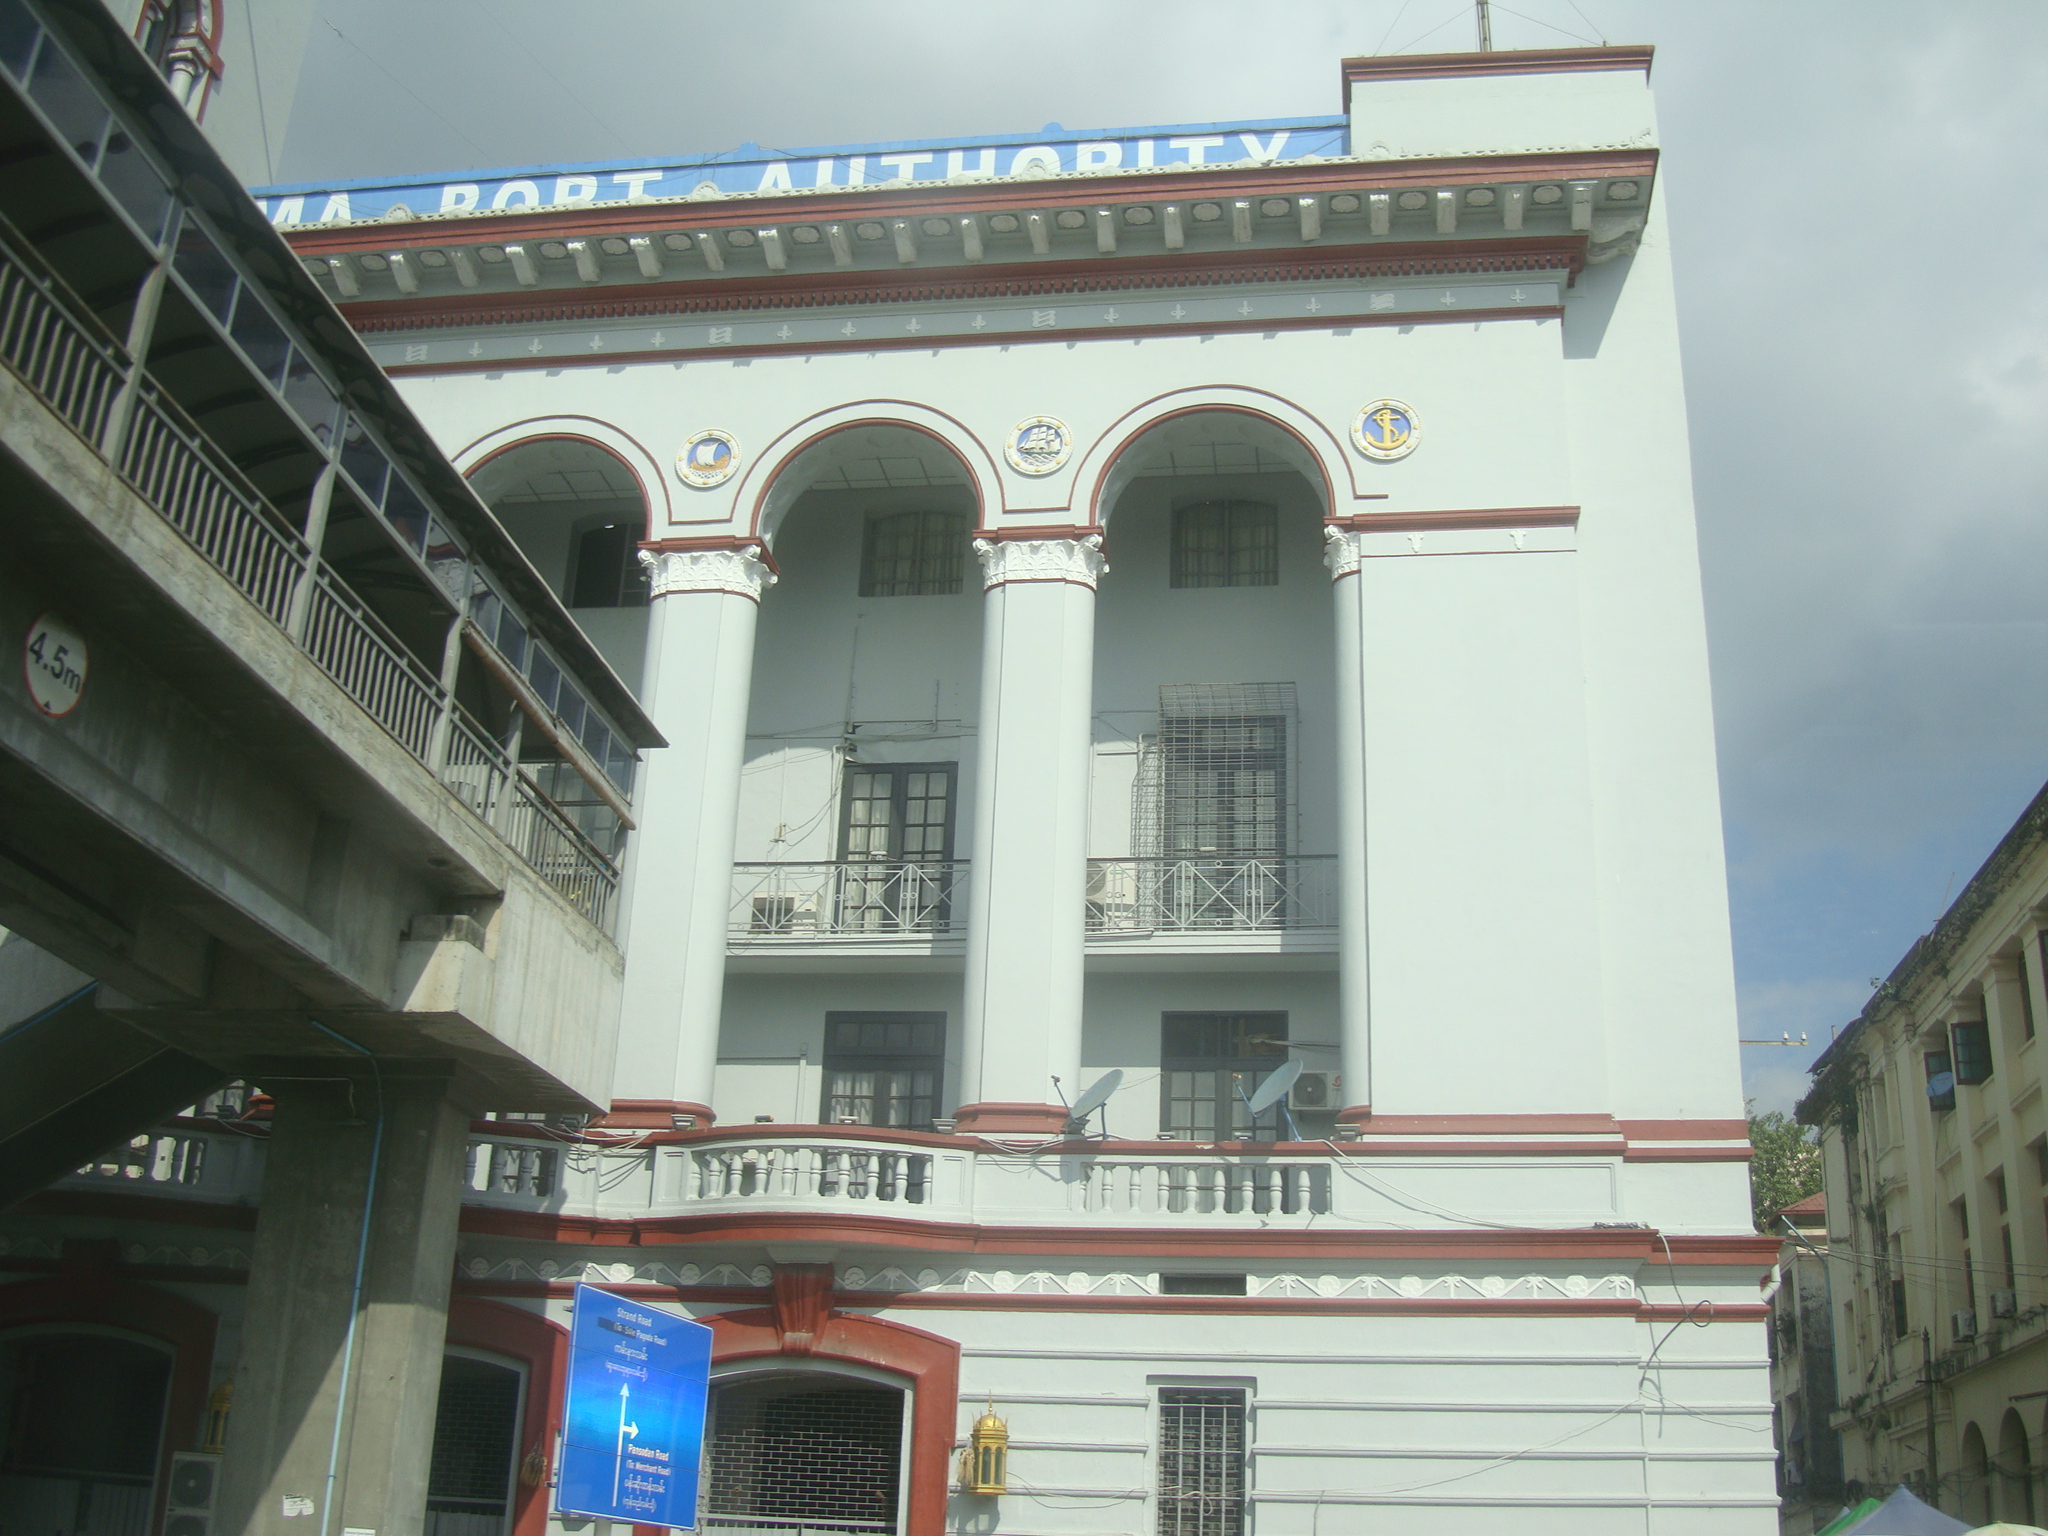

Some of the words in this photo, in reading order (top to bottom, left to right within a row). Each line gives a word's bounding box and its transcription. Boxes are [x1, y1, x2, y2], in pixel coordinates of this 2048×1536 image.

[29, 632, 81, 693] 4.5m
[617, 1307, 637, 1322] Strand
[637, 1314, 653, 1326] Road
[628, 1444, 655, 1458] Pansodan
[655, 1449, 669, 1461] Road
[636, 1462, 657, 1473] Merchant
